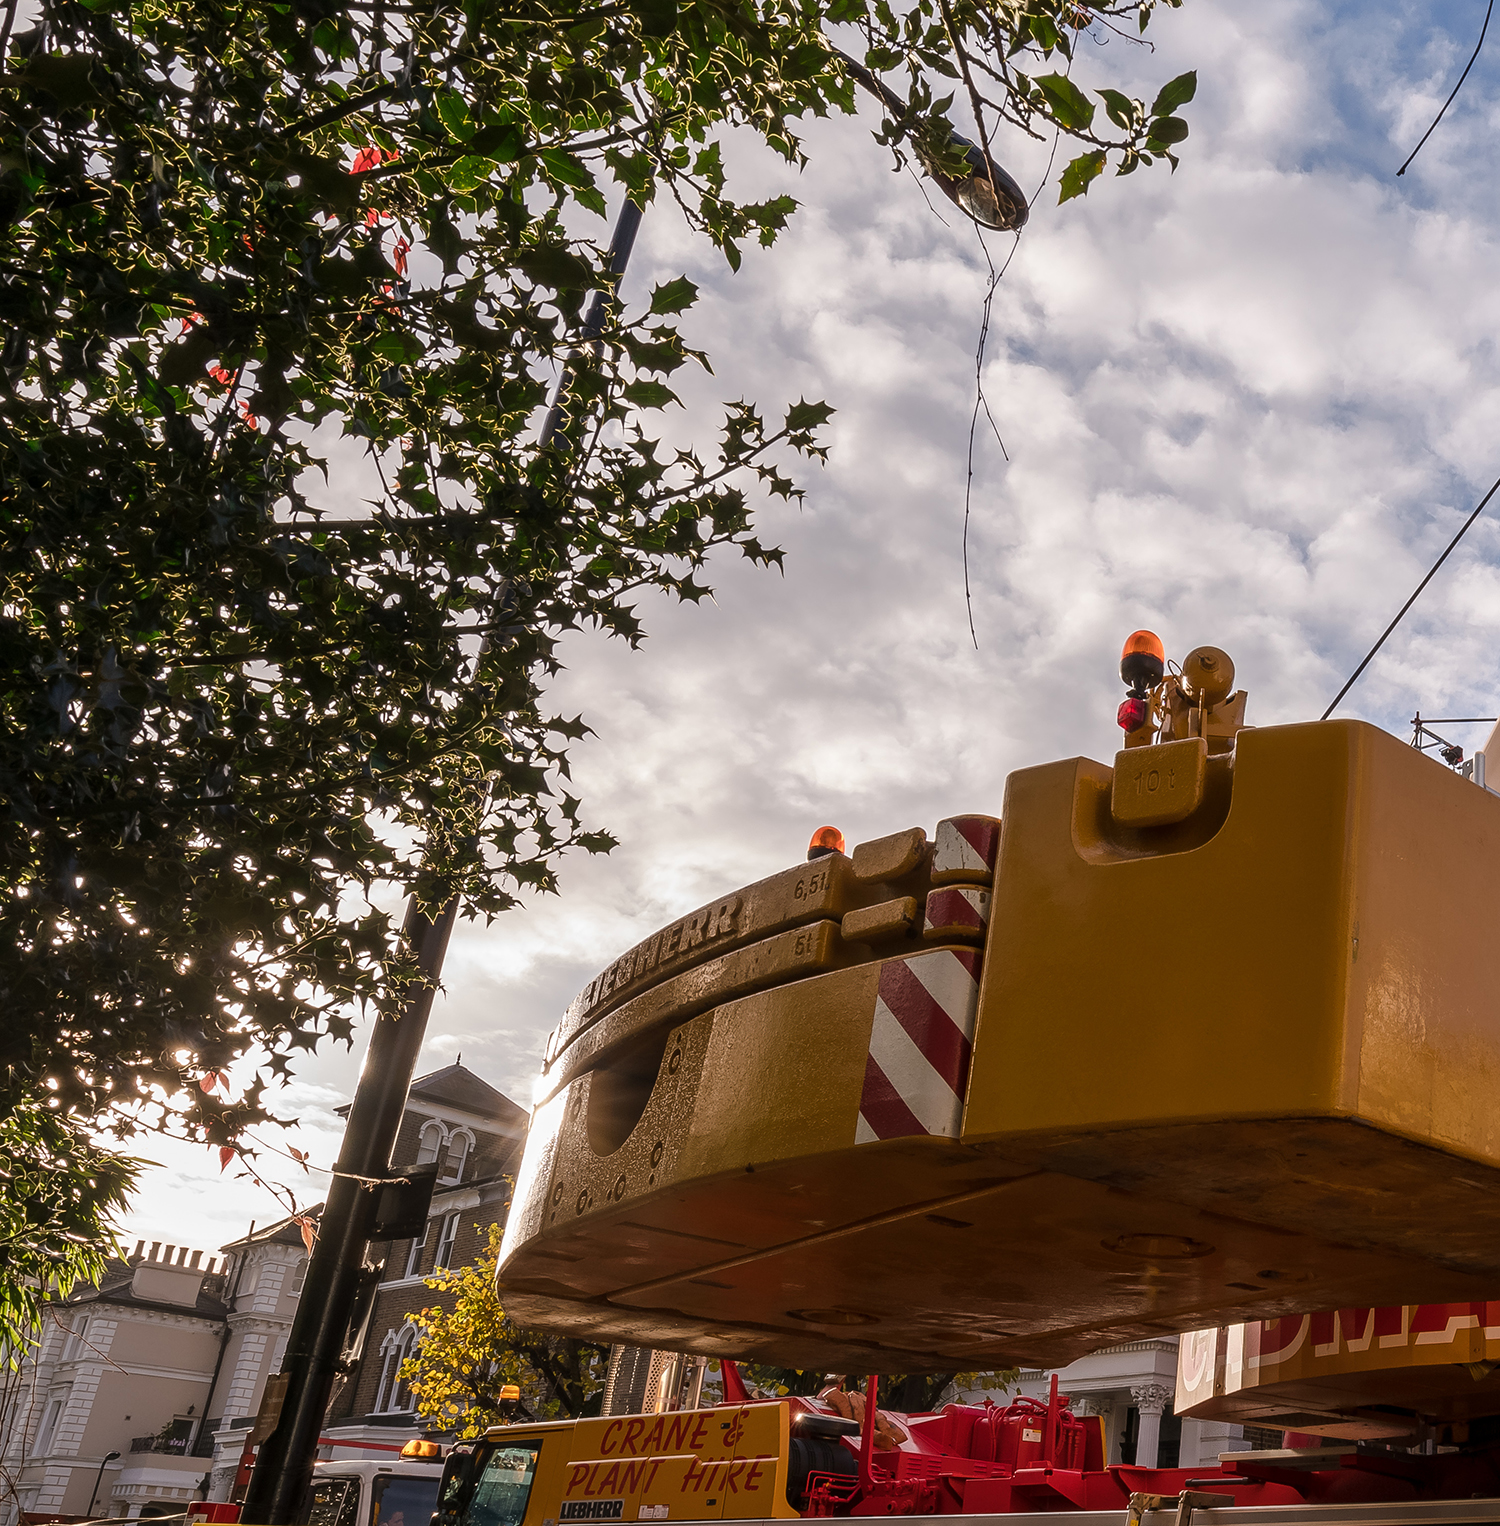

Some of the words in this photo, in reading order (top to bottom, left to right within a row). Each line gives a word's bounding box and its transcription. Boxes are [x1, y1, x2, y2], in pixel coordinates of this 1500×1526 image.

[1134, 769, 1160, 794] 10
[601, 1412, 715, 1456] CRANE
[722, 1410, 750, 1448] &
[565, 1458, 667, 1497] PLANT
[680, 1454, 773, 1494] HIRE
[561, 1501, 623, 1519] LIEBHERR
